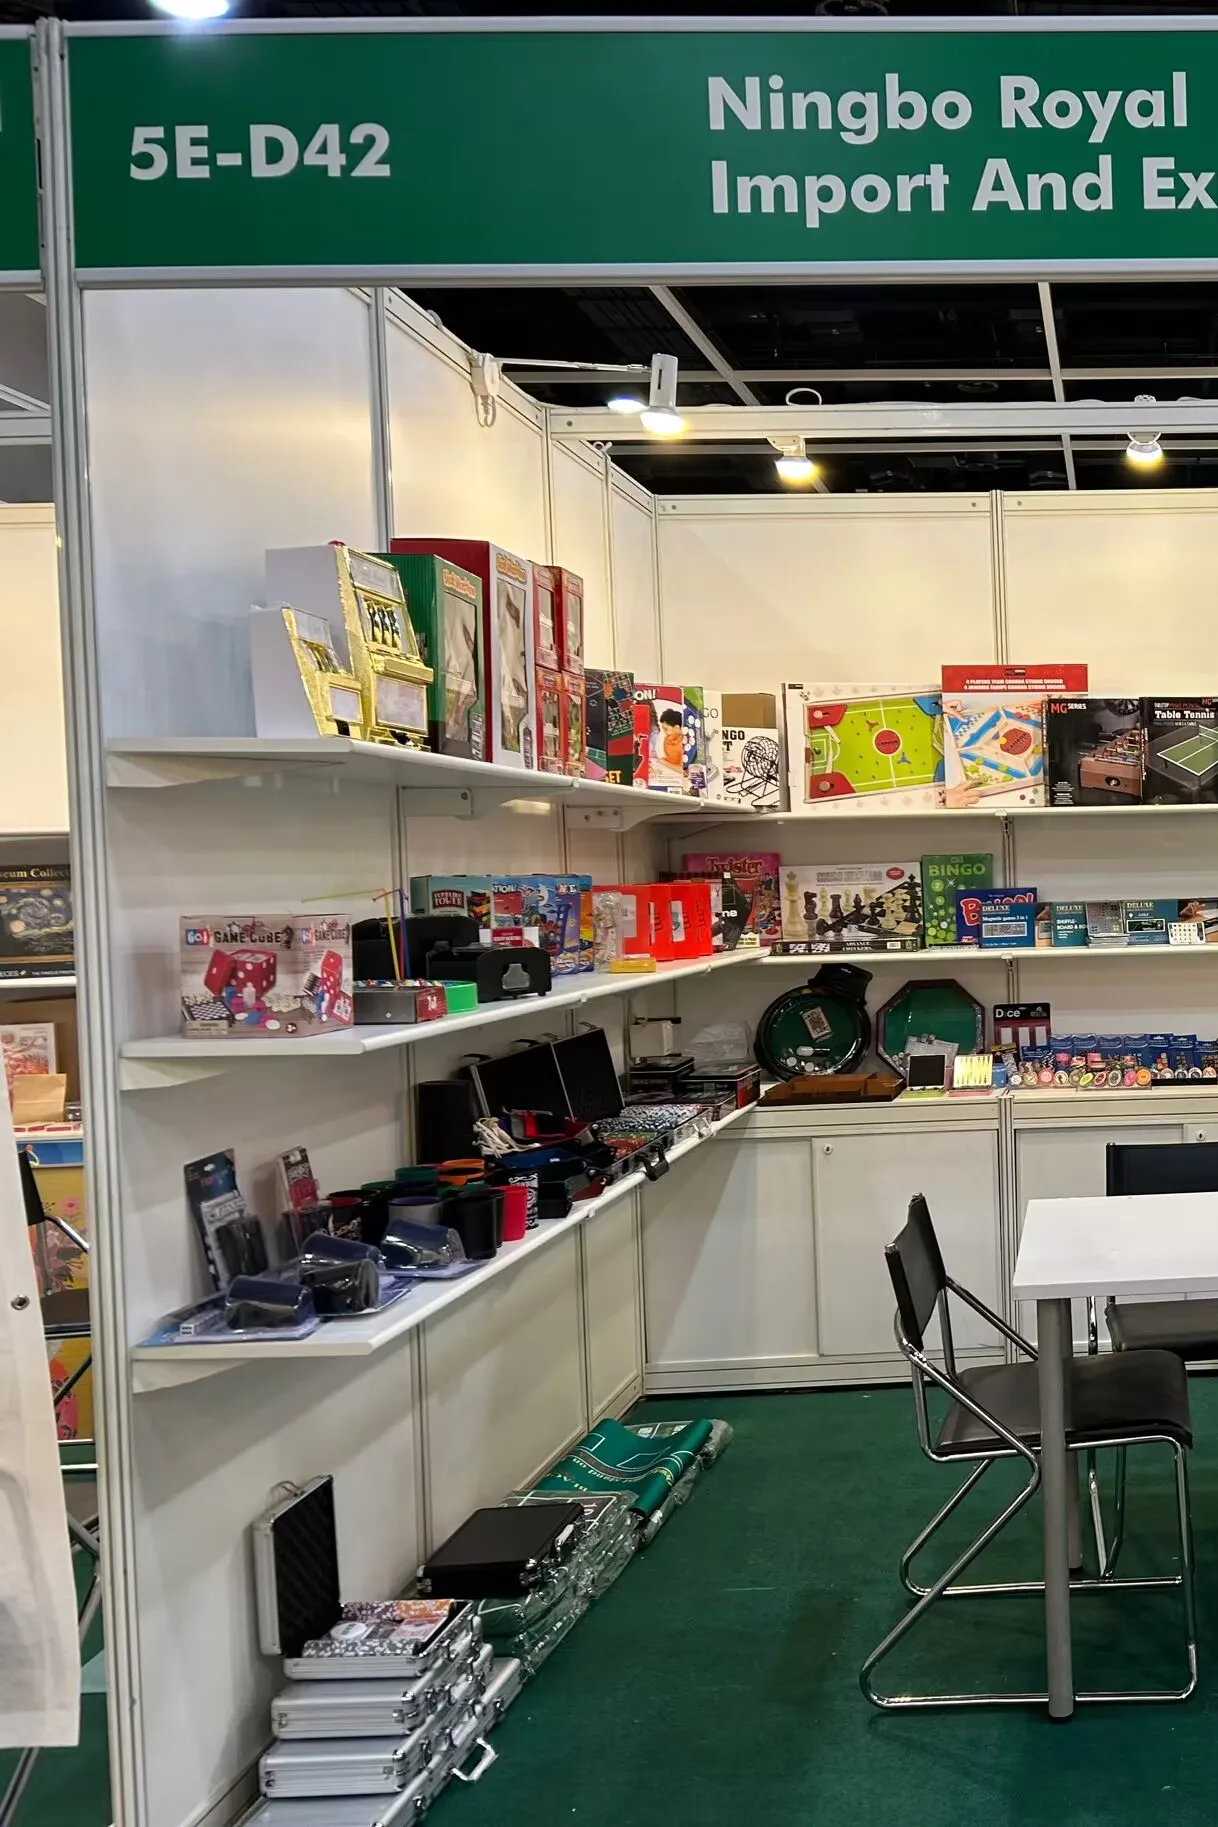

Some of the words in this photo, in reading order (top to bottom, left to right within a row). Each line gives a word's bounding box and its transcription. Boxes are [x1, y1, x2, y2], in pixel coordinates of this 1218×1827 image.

[708, 74, 973, 144] Ningbo
[1001, 71, 1188, 143] Royal
[129, 122, 391, 181] 5E-D42
[711, 159, 949, 229] Import
[972, 155, 1113, 214] And
[1050, 703, 1067, 714] MG
[1154, 710, 1182, 719] Table
[1184, 708, 1215, 719] Tennis
[706, 857, 763, 875] Twister
[928, 863, 986, 877] BINGO
[214, 931, 246, 943] GAME
[250, 931, 282, 943] CUBE
